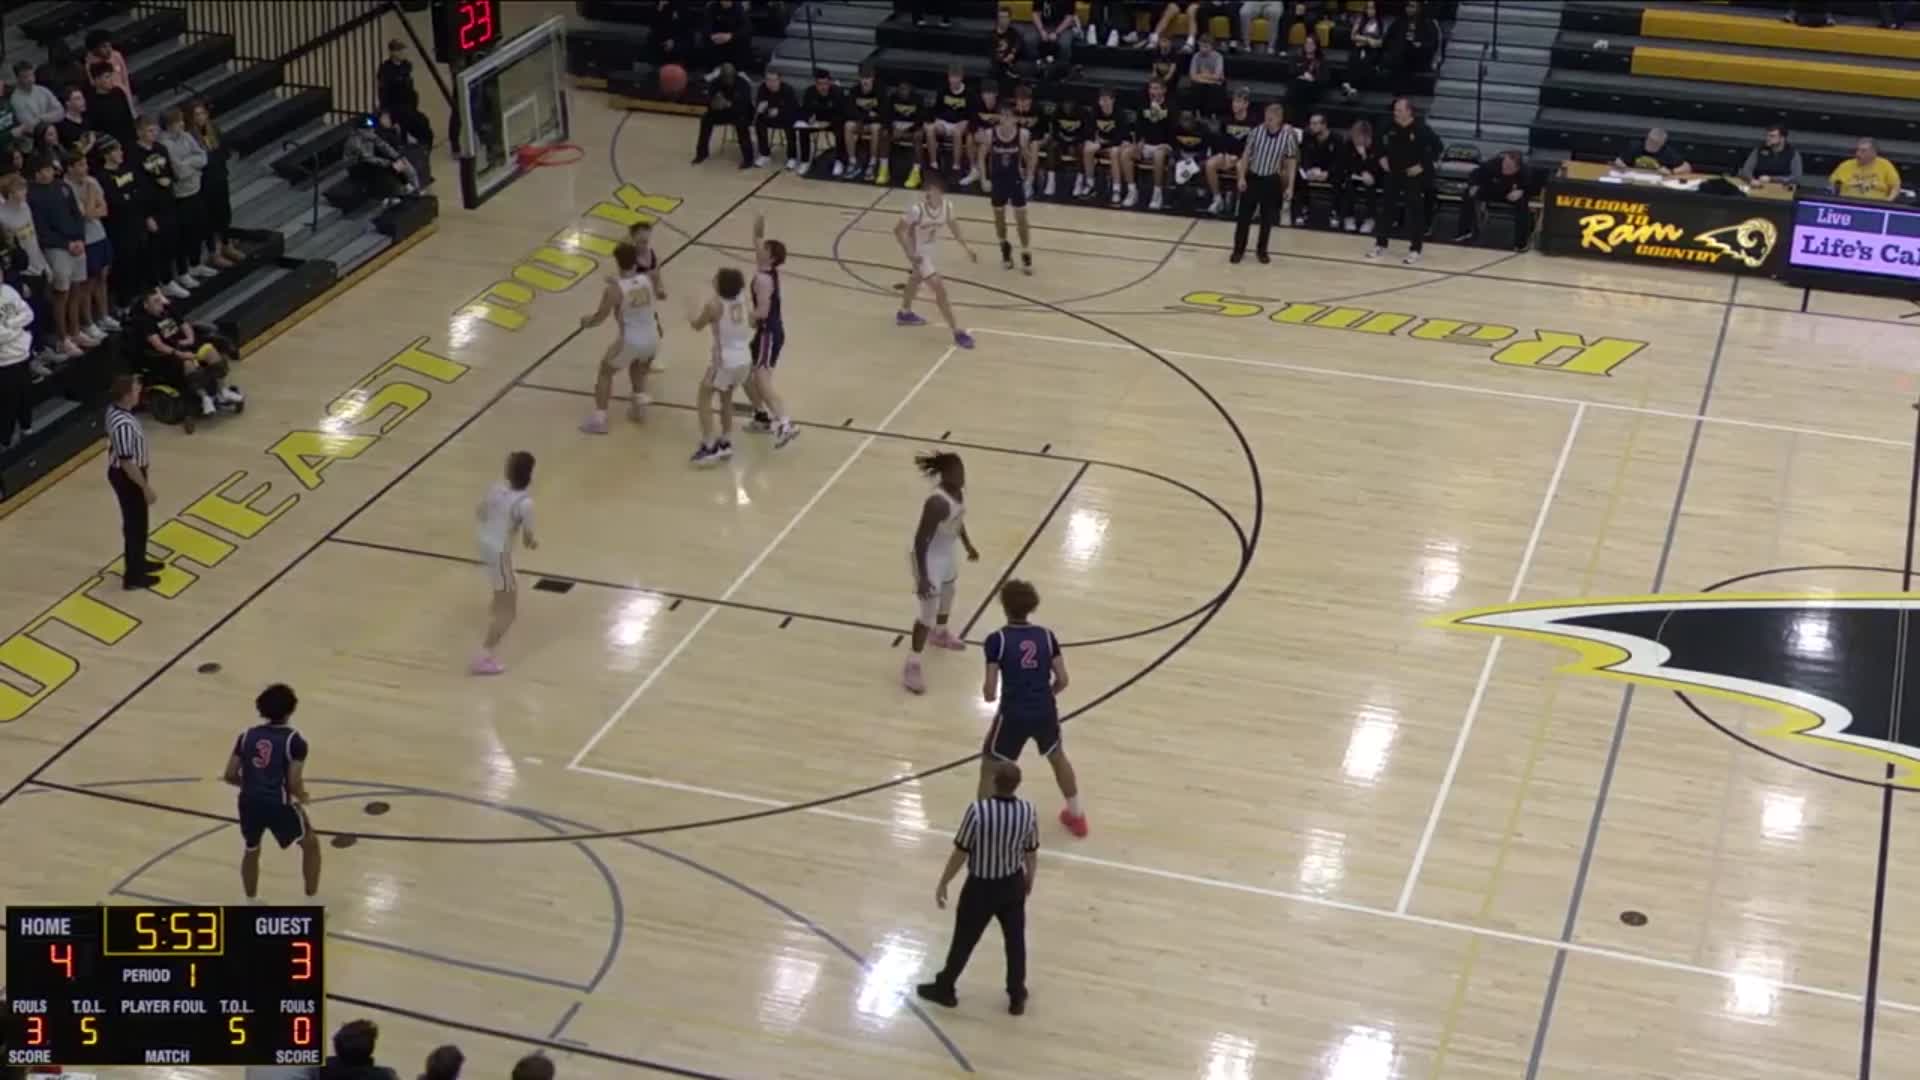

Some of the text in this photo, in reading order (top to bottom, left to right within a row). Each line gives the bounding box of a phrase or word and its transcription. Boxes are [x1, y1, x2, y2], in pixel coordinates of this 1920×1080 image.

[458, 0, 492, 50] 23
[1555, 194, 1650, 215] WELCOME
[1816, 207, 1852, 226] Live
[1578, 213, 1684, 253] Ram
[1626, 213, 1649, 226] TO
[1635, 244, 1723, 264] COUNTRY
[1800, 234, 1874, 261] Life's
[1164, 290, 1650, 378] Rams
[1018, 638, 1039, 669] 2
[251, 737, 274, 769] 3
